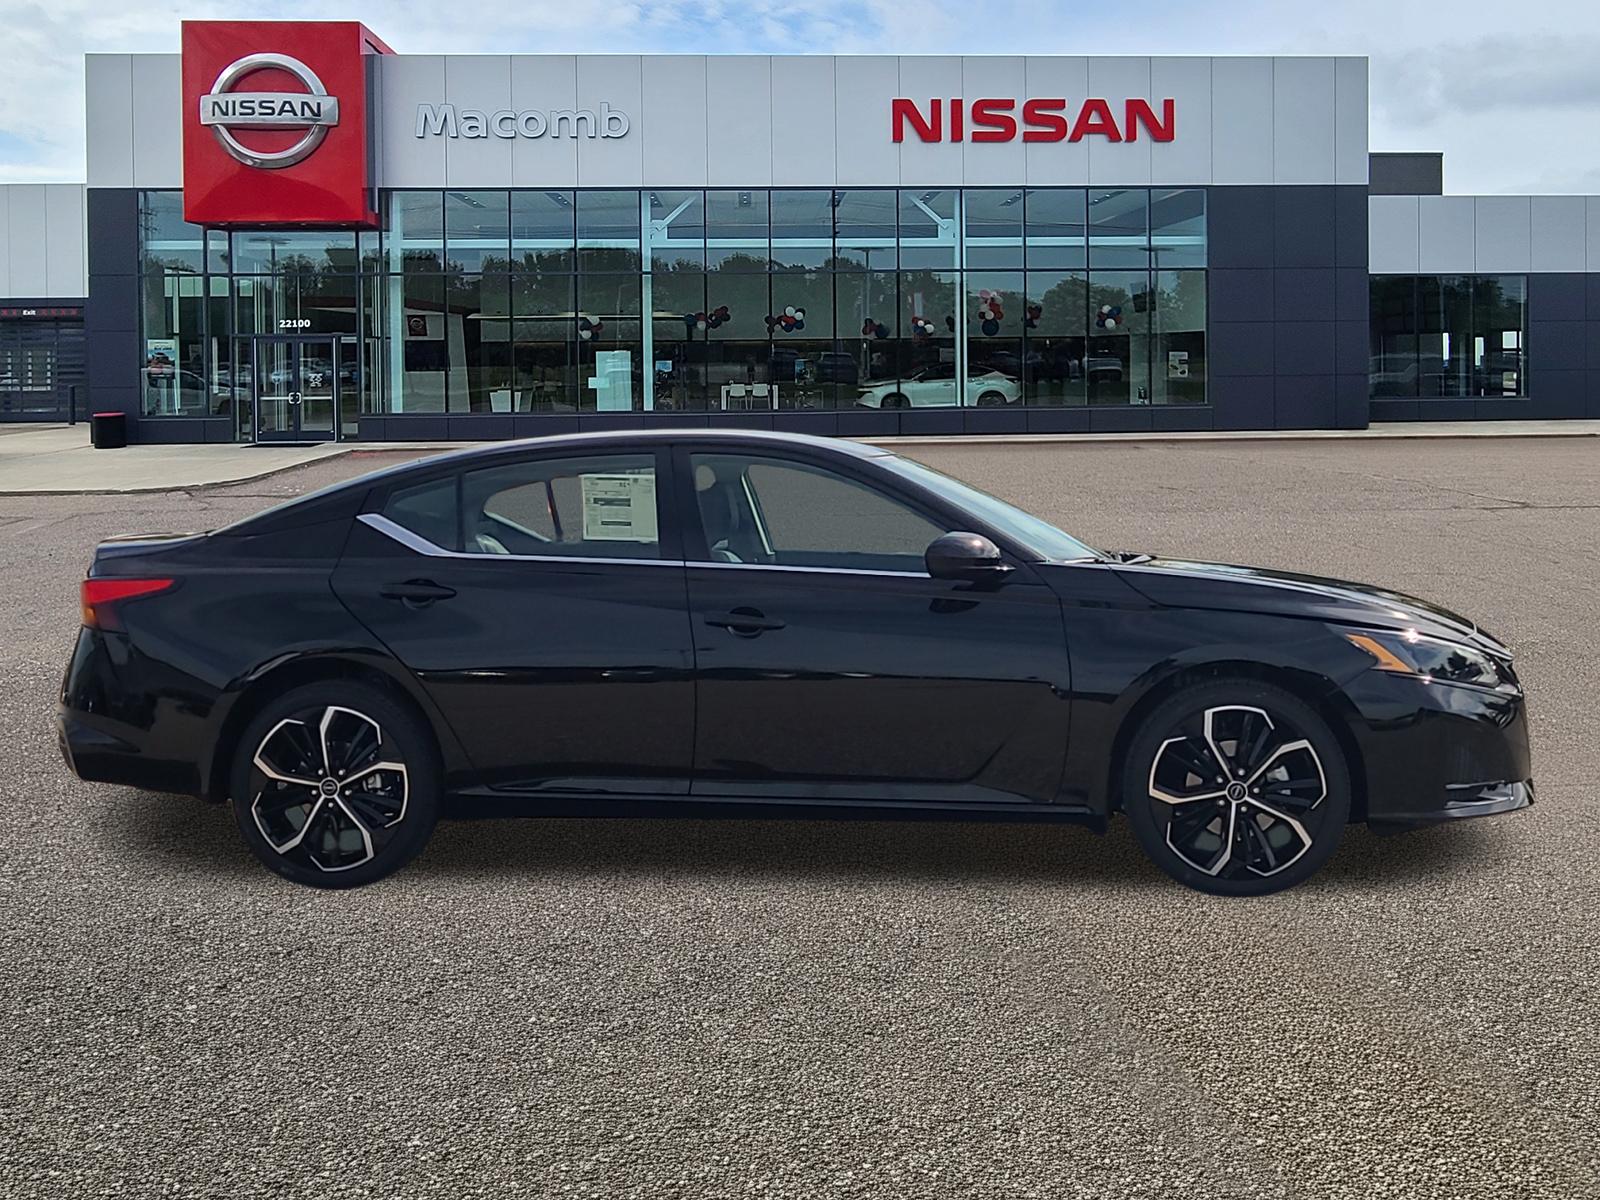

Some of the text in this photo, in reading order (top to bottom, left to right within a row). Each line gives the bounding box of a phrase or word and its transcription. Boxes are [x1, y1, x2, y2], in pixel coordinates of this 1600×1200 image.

[211, 100, 322, 118] NISSAN
[415, 101, 630, 139] Macomb
[891, 98, 1175, 143] NISSAN
[279, 319, 311, 328] 22100
